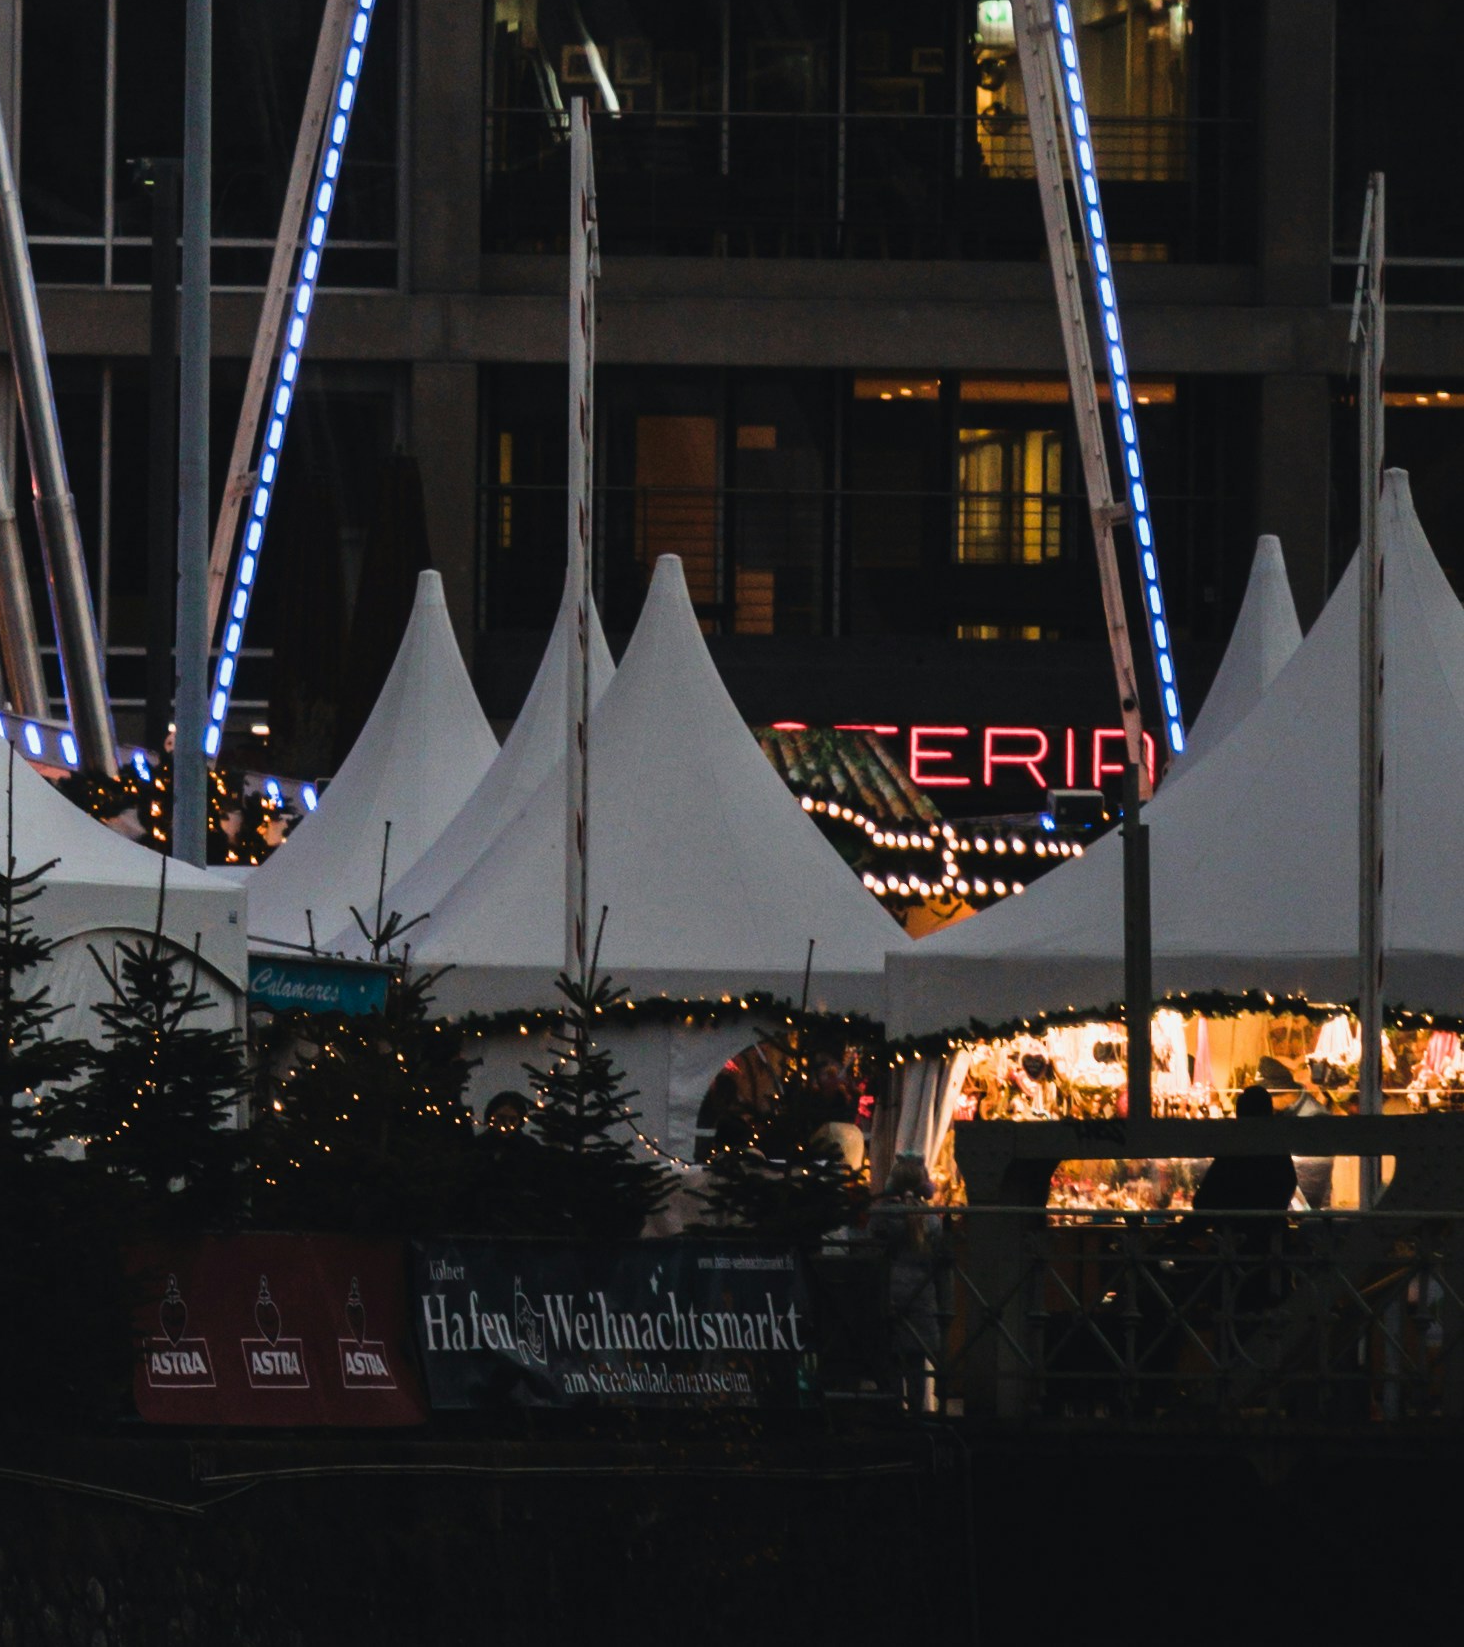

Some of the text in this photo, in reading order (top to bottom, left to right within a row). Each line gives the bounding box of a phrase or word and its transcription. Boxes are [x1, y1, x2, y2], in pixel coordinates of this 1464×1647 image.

[250, 967, 340, 1003] Calamares
[421, 1290, 807, 1352] Hafen Weihnachtsmarkt
[151, 1351, 208, 1376] ASTRA
[251, 1351, 302, 1376] ASTRA
[344, 1351, 390, 1377] ASTRA
[563, 1372, 589, 1395] am
